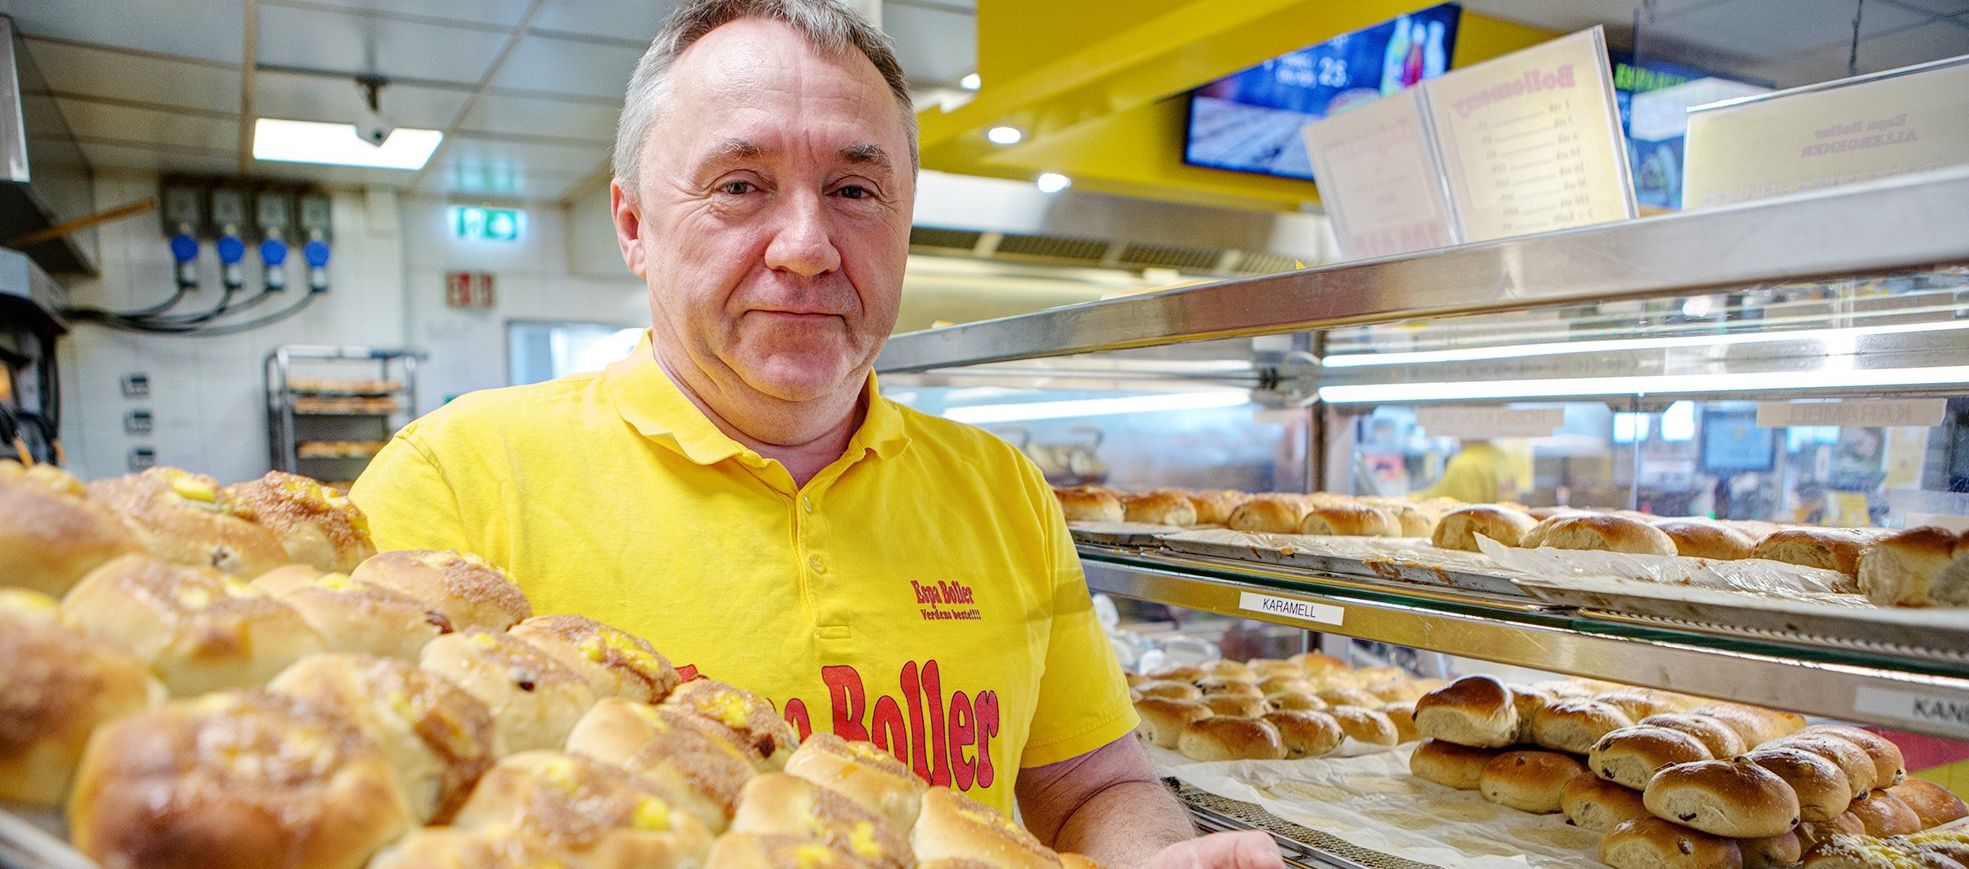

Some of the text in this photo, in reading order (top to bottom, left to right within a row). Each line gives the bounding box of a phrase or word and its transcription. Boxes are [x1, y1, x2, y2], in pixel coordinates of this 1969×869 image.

[911, 580, 974, 608] Espa Boller
[920, 608, 952, 621] Verdens
[1263, 598, 1316, 617] KARAMELL
[821, 660, 1000, 791] Boller
